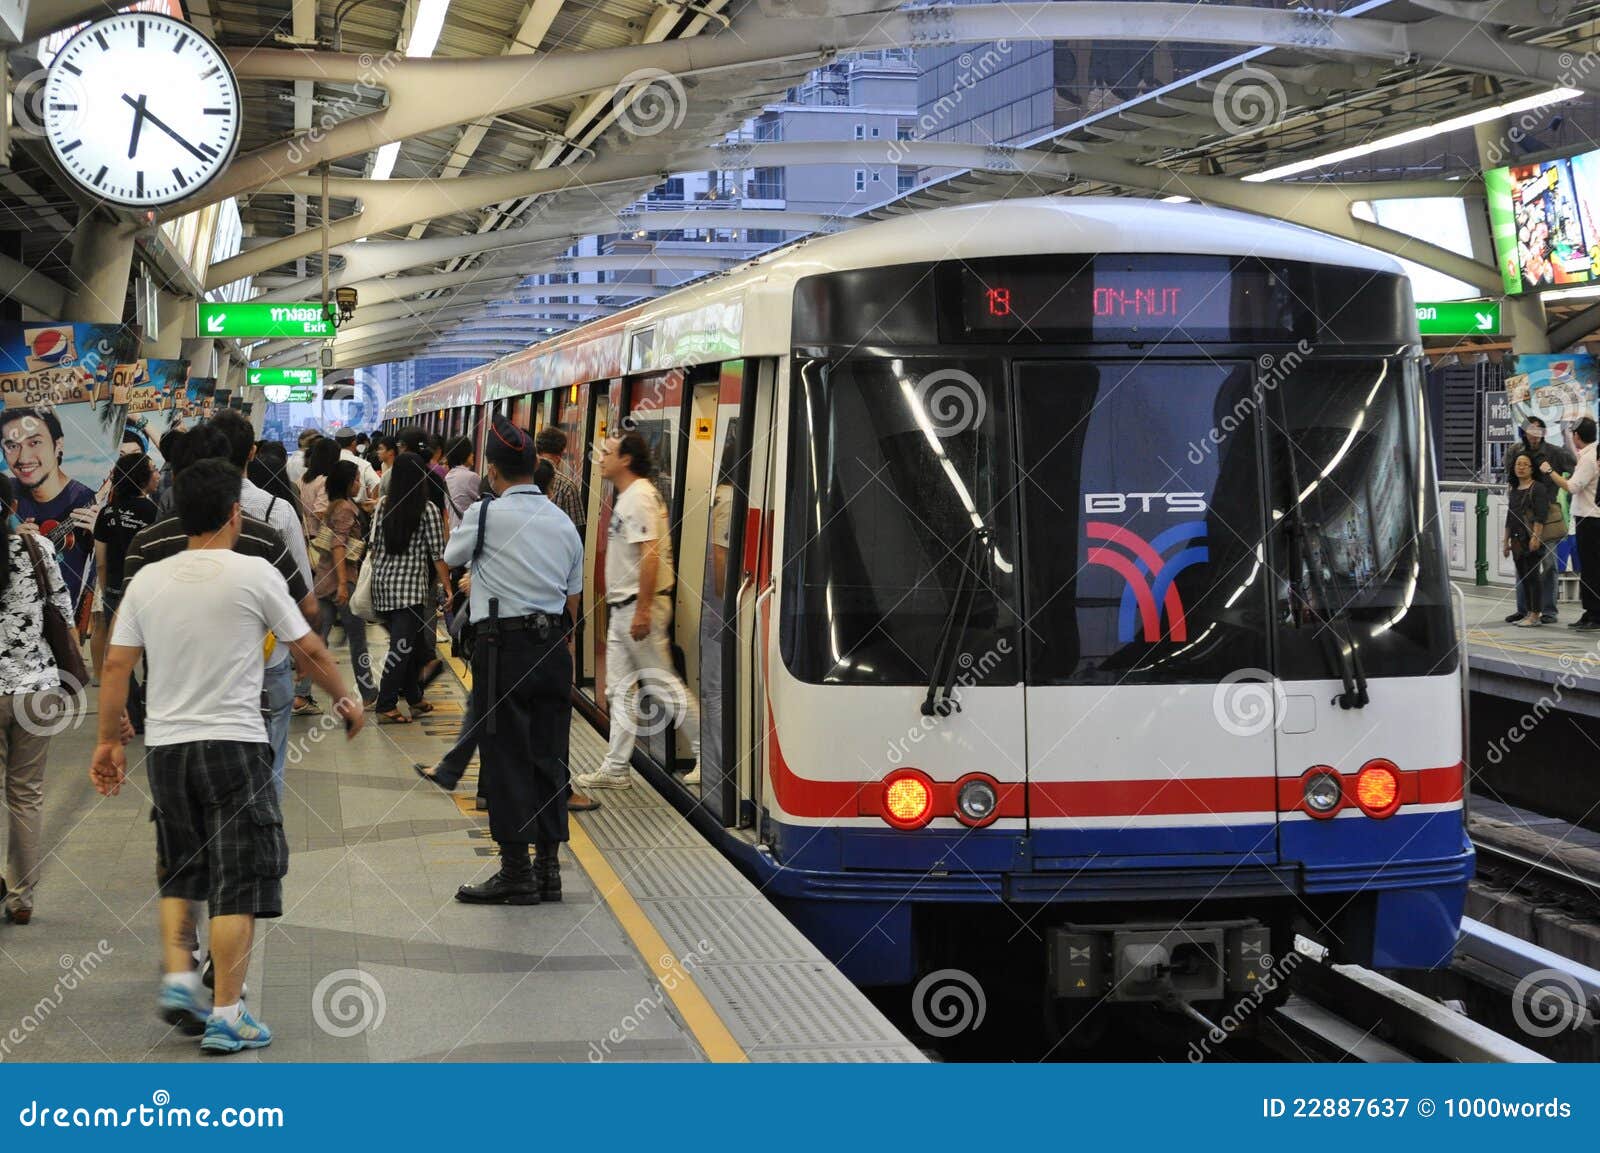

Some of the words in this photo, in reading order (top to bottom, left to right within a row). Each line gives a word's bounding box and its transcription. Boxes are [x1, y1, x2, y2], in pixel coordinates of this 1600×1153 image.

[1093, 287, 1182, 316] ON-NUT
[304, 322, 327, 333] Exit
[1085, 492, 1207, 513] BTS
